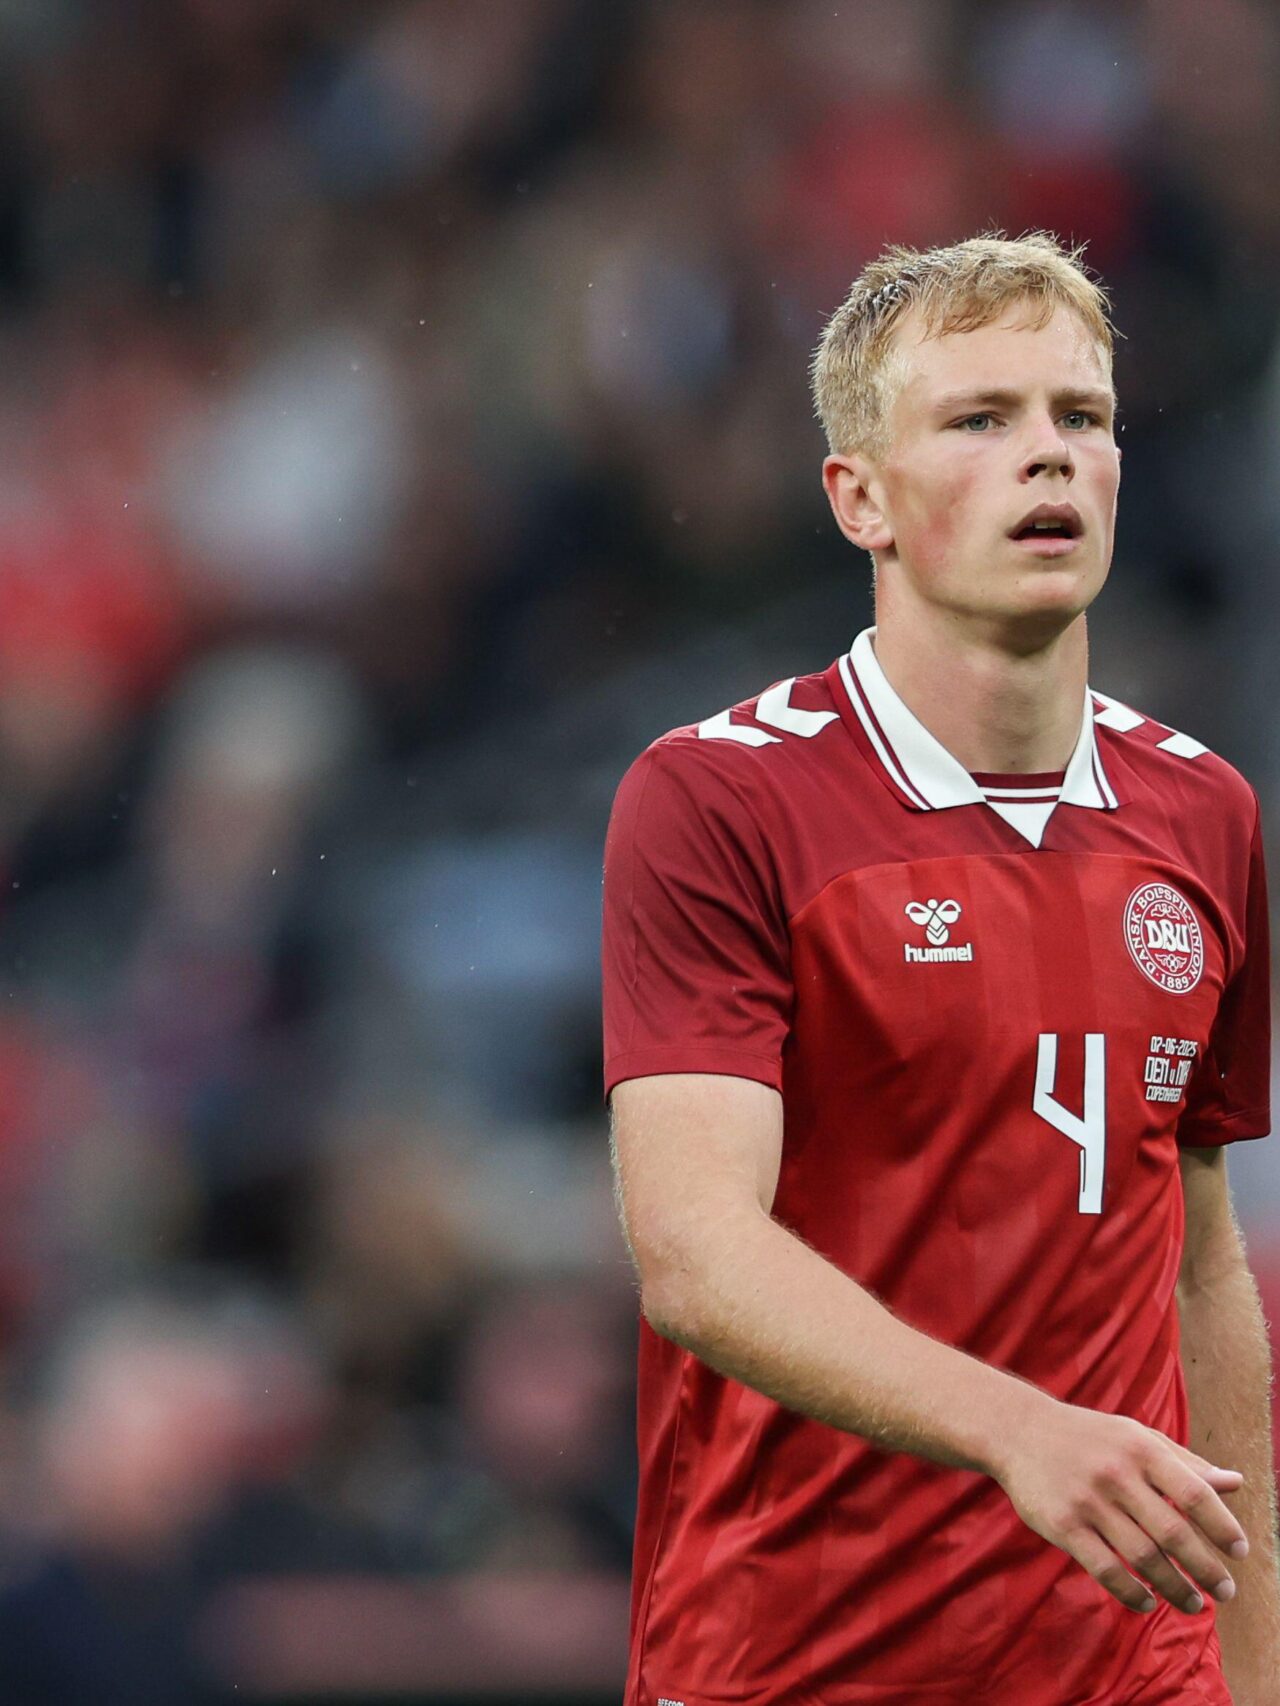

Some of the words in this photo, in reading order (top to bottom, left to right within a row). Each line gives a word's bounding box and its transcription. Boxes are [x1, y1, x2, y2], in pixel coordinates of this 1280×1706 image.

[1131, 912, 1157, 974] DANSK
[1145, 919, 1190, 953] DBU
[904, 944, 973, 963] hummel
[1160, 974, 1189, 990] 1889
[1144, 1056, 1170, 1084] DEN
[1033, 1033, 1105, 1214] 4
